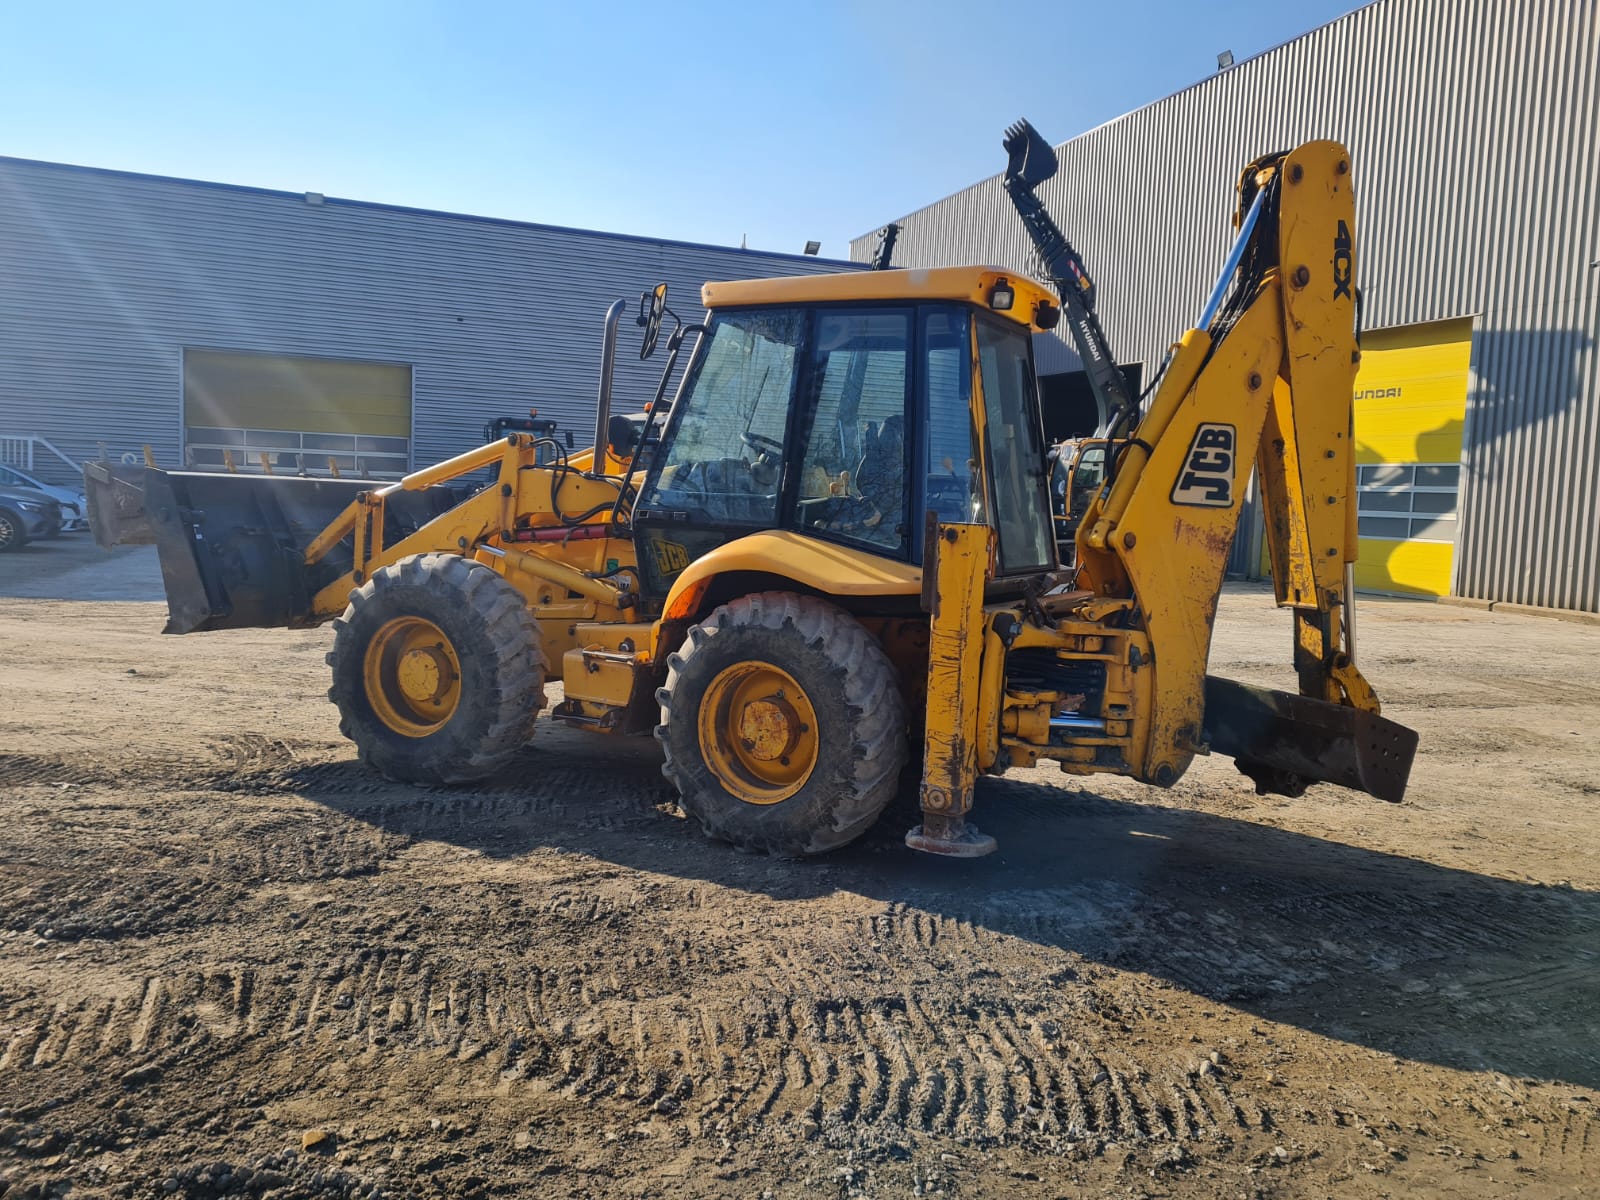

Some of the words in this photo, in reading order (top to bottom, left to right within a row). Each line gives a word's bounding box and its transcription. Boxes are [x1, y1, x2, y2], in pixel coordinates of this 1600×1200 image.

[1333, 219, 1352, 302] 4CX
[1079, 319, 1101, 362] HYUNDAI
[1353, 387, 1402, 401] UNDAI
[1178, 428, 1233, 502] JCB
[655, 541, 689, 573] JCB
